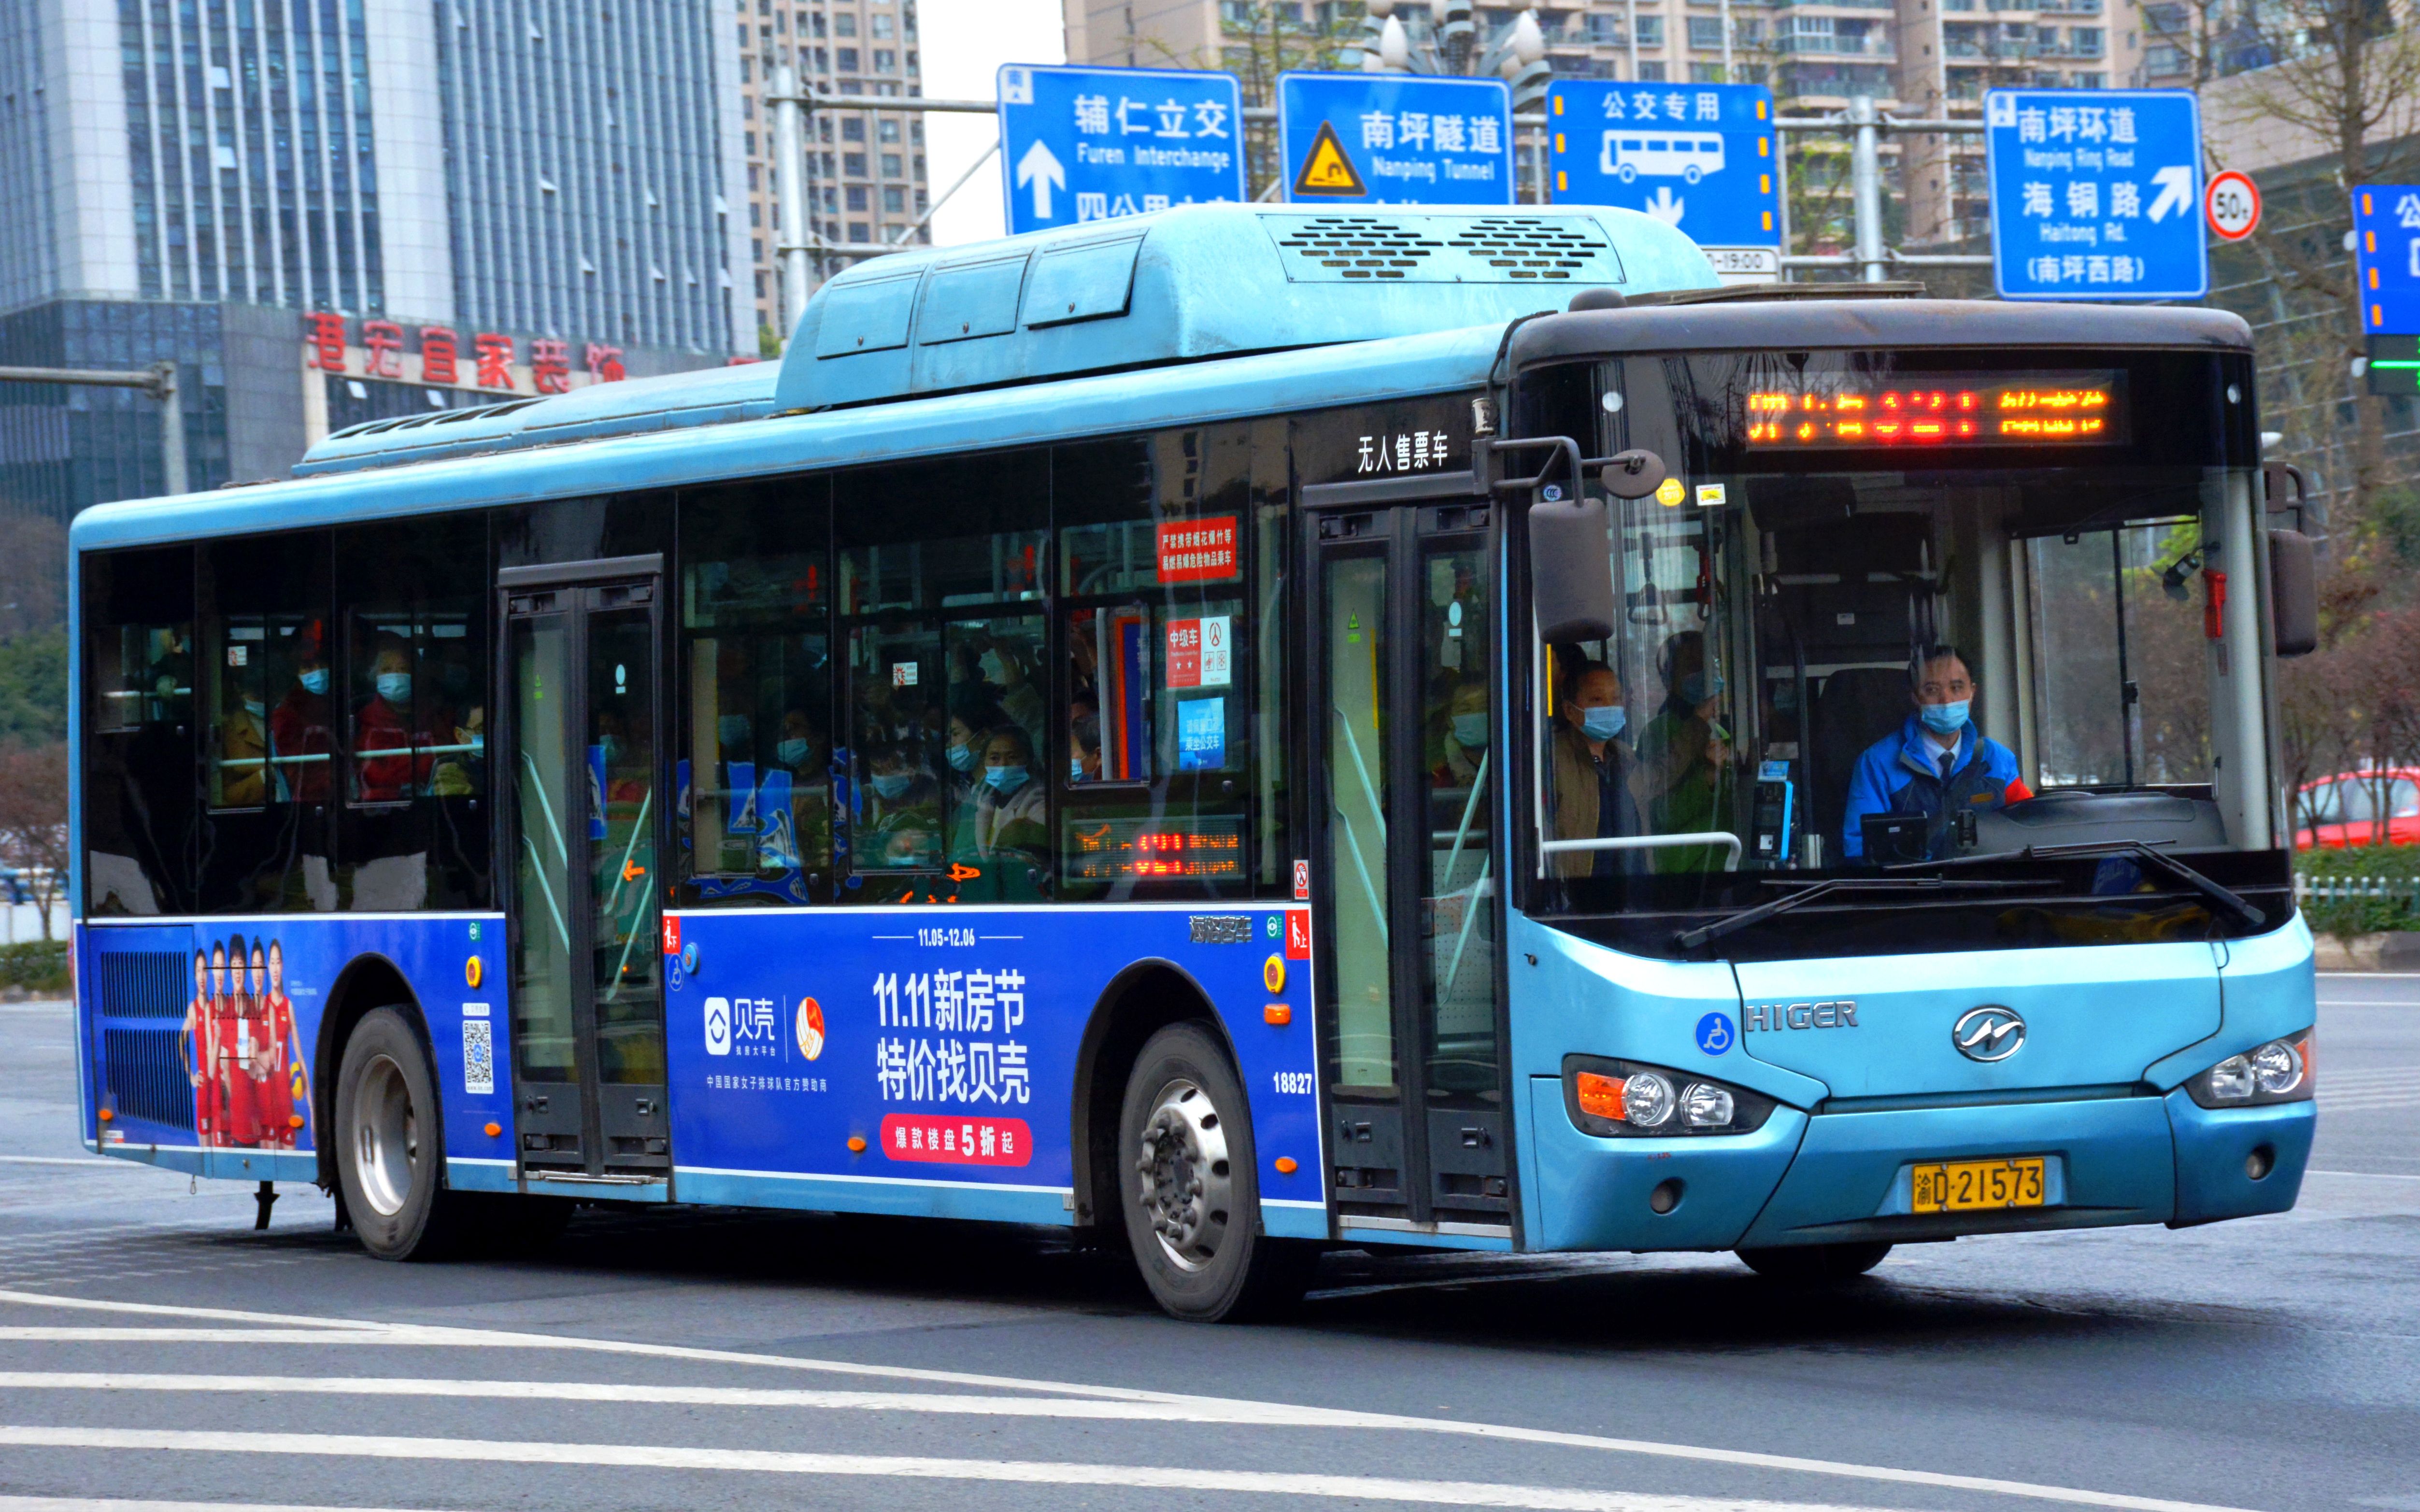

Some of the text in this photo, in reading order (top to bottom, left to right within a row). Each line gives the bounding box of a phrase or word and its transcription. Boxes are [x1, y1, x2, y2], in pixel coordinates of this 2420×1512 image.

[1074, 95, 1228, 139] 辅仁立交
[1602, 91, 1720, 121] 公交专用
[1359, 110, 1502, 154] 南坪隧道
[2017, 106, 2138, 143] 南坪环道
[1077, 142, 1230, 173] Furen Interchange
[1372, 156, 1495, 184] Nanping Tunnel
[2027, 254, 2145, 283] (南坪西路)
[1357, 430, 1448, 474] 无人售票车
[1162, 528, 1232, 549] 严禁携带烟花爆竹等
[1162, 550, 1232, 571] 易燃易爆危险物品乘车
[1169, 628, 1198, 648] 中级车
[1185, 735, 1220, 751] 乘坐公交车
[670, 936, 677, 948] 下
[918, 928, 975, 947] 11.05-12.06
[1300, 934, 1308, 948] 上
[873, 968, 1025, 1034] 11.11新房节
[735, 997, 775, 1041] 贝壳
[1745, 1001, 1859, 1032] HIGER
[736, 1045, 776, 1057] 找房大平台
[707, 1074, 827, 1092] 中国国家女子排球队官方赞助商
[877, 1037, 1030, 1105] 特价找贝壳
[1273, 1072, 1312, 1094] 18827
[895, 1124, 1014, 1157] 爆款楼盘5折起
